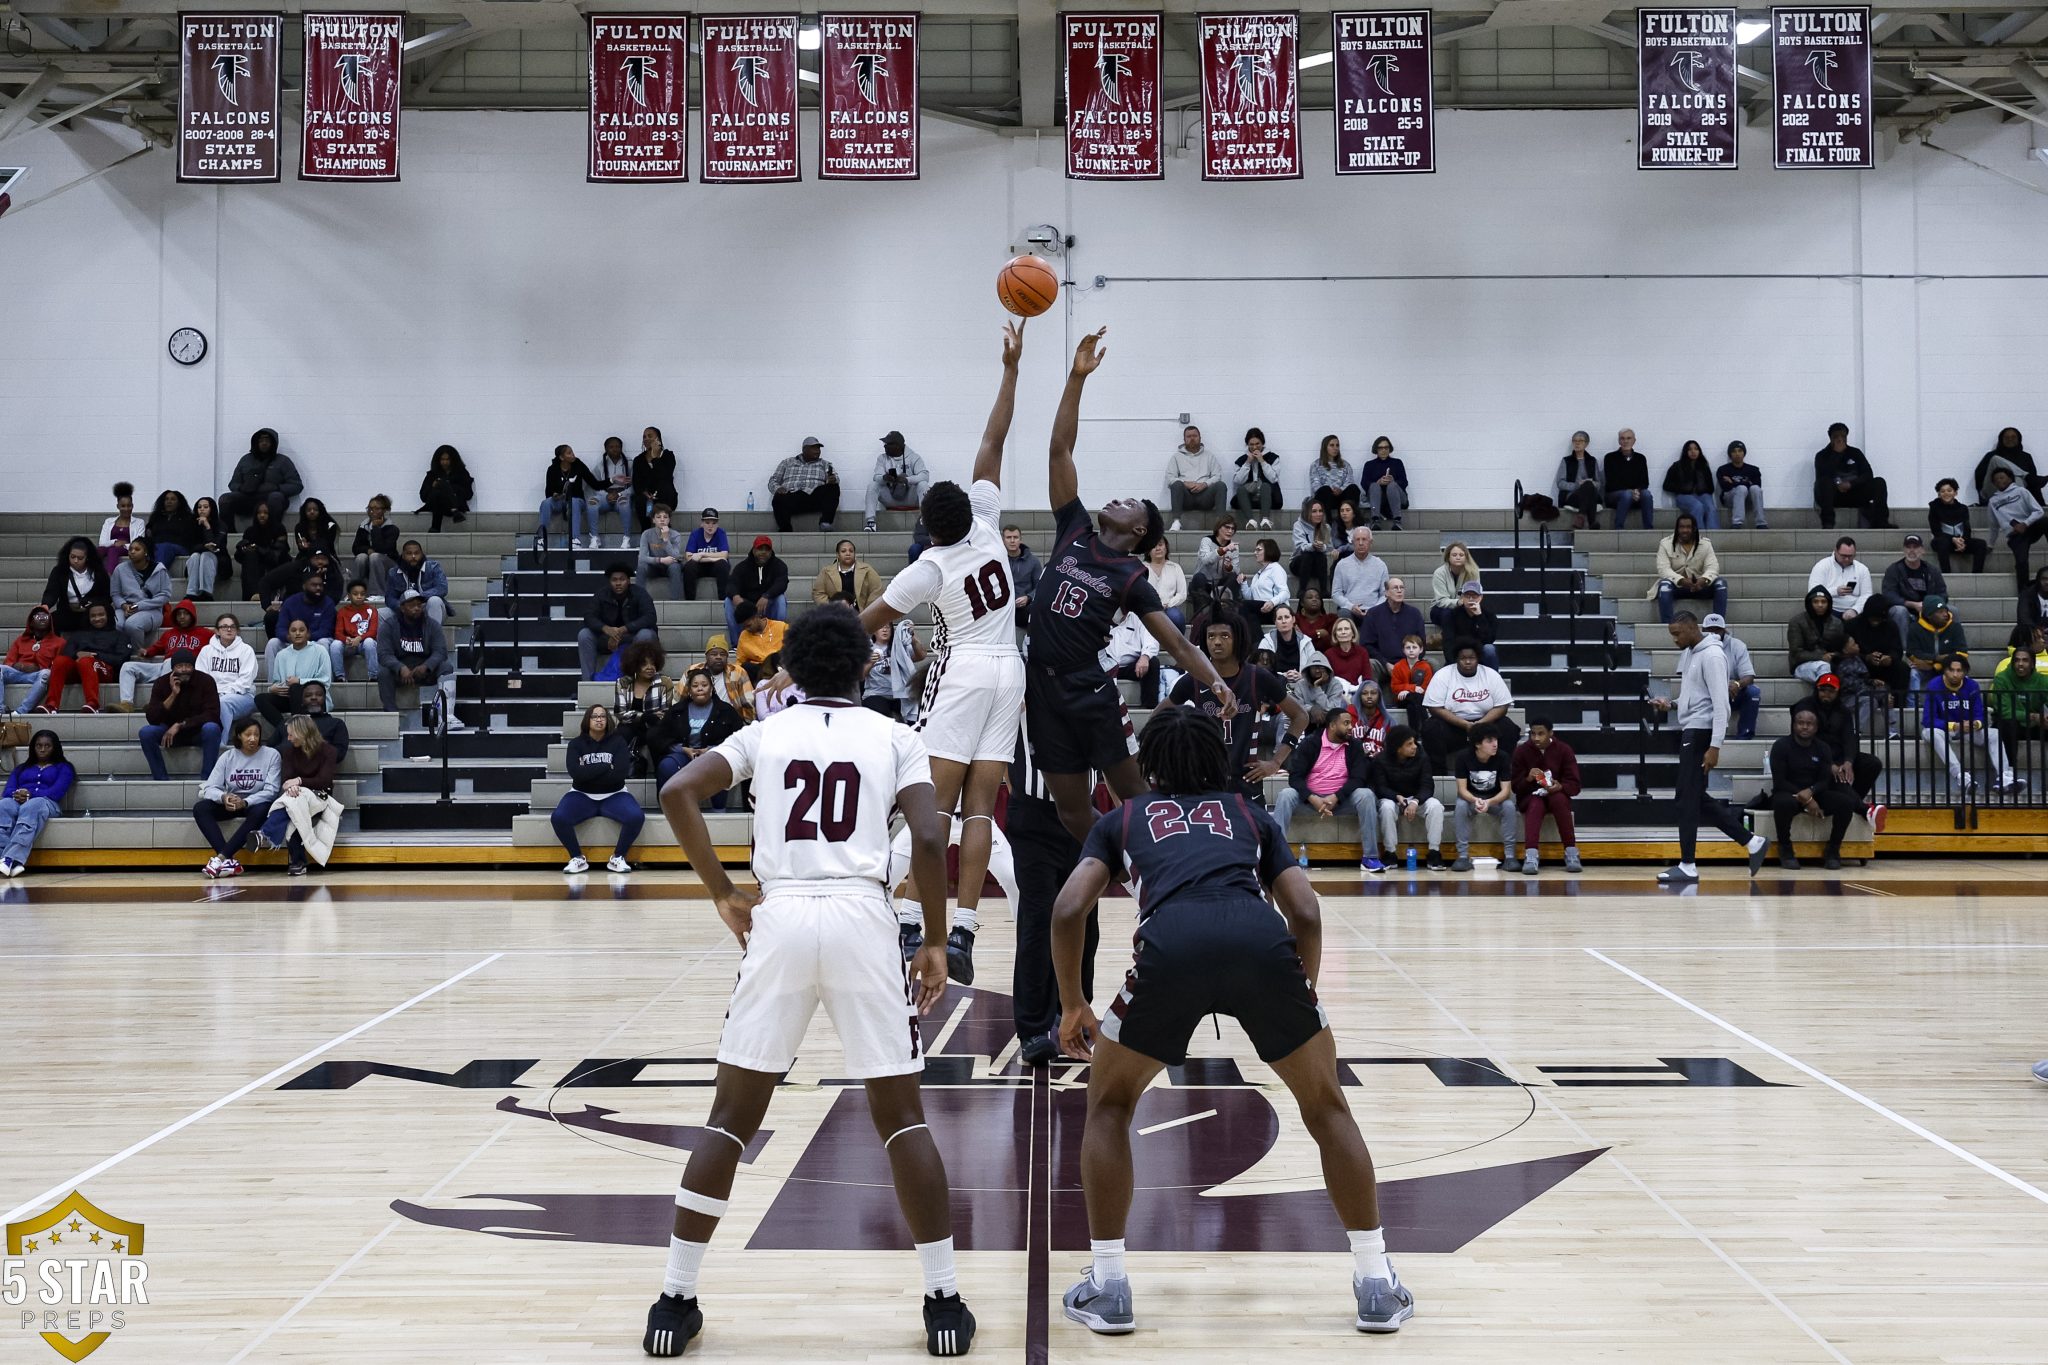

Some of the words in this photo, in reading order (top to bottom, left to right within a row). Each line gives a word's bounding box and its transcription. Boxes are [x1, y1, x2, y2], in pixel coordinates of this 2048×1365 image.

[1070, 22, 1156, 37] FULTON
[1340, 16, 1423, 37] FULTON
[1645, 14, 1728, 34] FULTON
[1779, 13, 1862, 33] FULTON
[186, 24, 275, 38] FULTON
[310, 23, 398, 38] FULTON
[595, 25, 682, 40] FULTON
[706, 25, 793, 40] FULTON
[826, 23, 913, 38] FULTON
[1204, 24, 1292, 39] FULTON
[320, 42, 386, 50] BASKETBALL
[837, 42, 902, 50] BASKETBALL
[1072, 41, 1095, 49] BOYS
[1098, 41, 1153, 49] BASKETBALL
[1215, 43, 1281, 51] BASKETBALL
[1340, 41, 1363, 50] BOYS
[1365, 40, 1424, 50] BASKETBALL
[1645, 37, 1668, 47] BOYS
[1670, 37, 1728, 46] BASKETBALL
[1779, 36, 1801, 46] BOYS
[1804, 35, 1863, 45] BASKETBALL
[606, 44, 671, 52] BASKETBALL
[717, 44, 782, 52] BASKETBALL
[1344, 98, 1422, 114] FALCONS
[1648, 94, 1726, 109] FALCONS
[1783, 94, 1861, 110] FALCONS
[190, 111, 270, 125] FALCONS
[312, 111, 392, 125] FALCONS
[599, 113, 679, 126] FALCONS
[711, 113, 790, 126] FALCONS
[830, 111, 909, 124] FALCONS
[1074, 111, 1152, 126] FALCONS
[1211, 111, 1290, 126] FALCONS
[1344, 117, 1368, 131] 2018
[1397, 116, 1424, 130] 25-9
[1648, 113, 1672, 126] 2019
[1701, 113, 1727, 126] 28-5
[1782, 114, 1809, 126] 2022
[1836, 113, 1862, 126] 30-6
[185, 130, 244, 140] 2007-2008
[250, 130, 275, 140] 28-4
[313, 130, 344, 140] 2009
[363, 130, 390, 140] 30-6
[600, 131, 627, 141] 2010
[652, 131, 678, 141] 29-3
[713, 131, 738, 142] 2011
[762, 131, 789, 141] 21-11
[829, 129, 856, 139] 2013
[882, 128, 909, 139] 24-9
[1075, 129, 1100, 139] 2015
[1126, 129, 1152, 140] 28-5
[1211, 130, 1238, 141] 2016
[1264, 129, 1290, 139] 32-2
[1666, 132, 1708, 146] STATE
[1802, 132, 1844, 146] STATE
[205, 144, 256, 155] STATE
[326, 144, 377, 155] STATE
[844, 143, 894, 154] STATE
[1089, 143, 1137, 155] STATE
[1227, 143, 1276, 155] STATE
[1363, 136, 1405, 150] STATE
[614, 145, 664, 157] STATE
[726, 145, 776, 157] STATE
[1651, 148, 1724, 162] RUNNER-UP
[1785, 148, 1824, 162] FINAL
[1829, 148, 1861, 162] FOUR
[198, 159, 262, 170] CHAMPS
[315, 158, 387, 170] CHAMPIONS
[597, 159, 680, 171] TOURNAMENT
[709, 159, 793, 172] TOURNAMENT
[827, 157, 911, 170] TOURNAMENT
[1075, 158, 1151, 171] RUNNER-UP
[1211, 157, 1292, 171] CHAMPION
[1349, 151, 1421, 167] RUNNER-UP
[1055, 555, 1112, 598] Bearden
[963, 559, 1011, 621] 10
[1050, 580, 1089, 619] 13
[1452, 687, 1490, 700] Chicago
[784, 759, 861, 843] 20
[1145, 800, 1234, 843] 24
